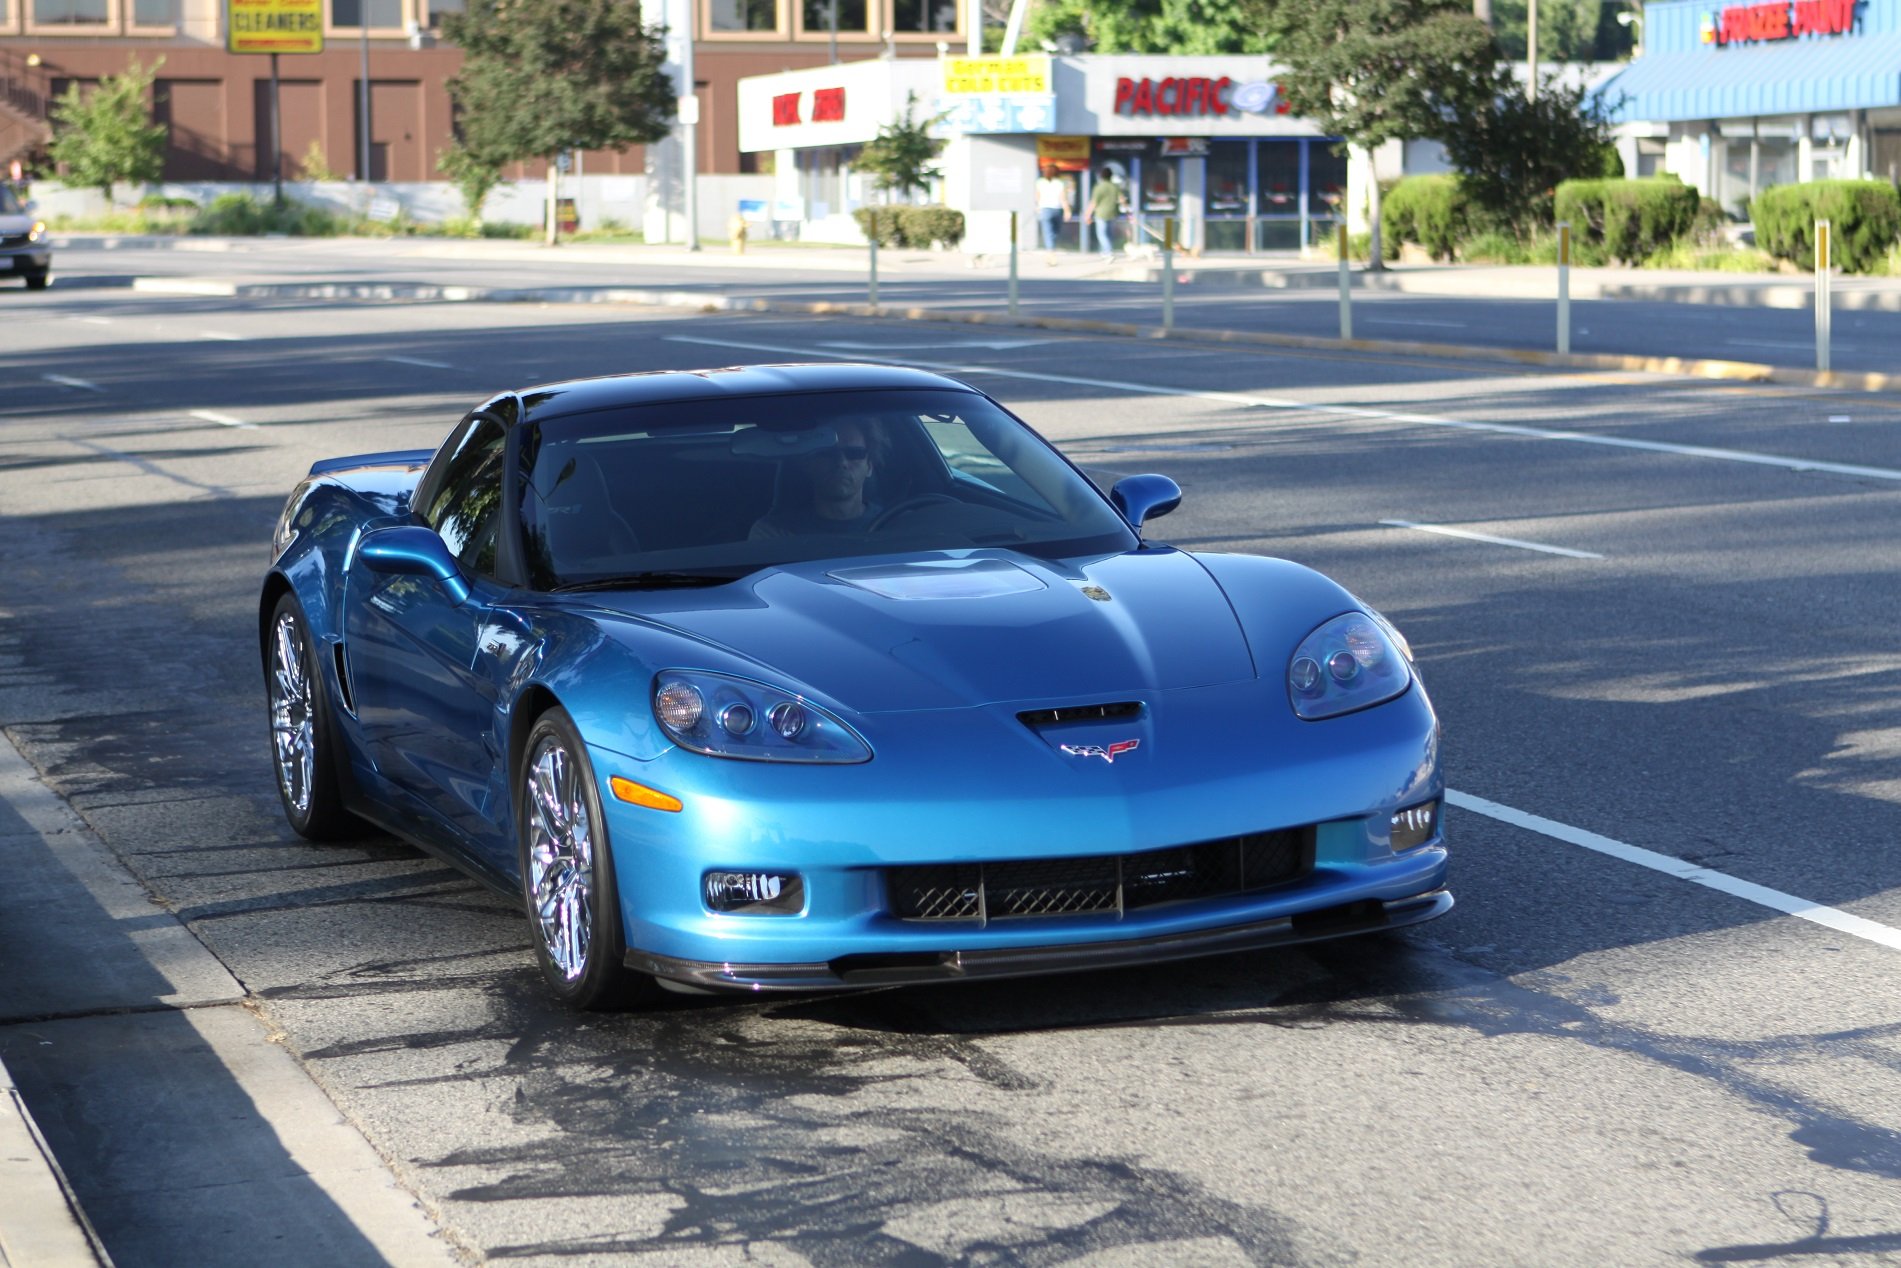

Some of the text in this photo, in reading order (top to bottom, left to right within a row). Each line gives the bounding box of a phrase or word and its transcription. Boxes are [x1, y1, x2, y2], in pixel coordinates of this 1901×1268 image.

[234, 12, 320, 32] CLEANERS
[1719, 0, 1855, 45] FRAZEE PAINT
[1113, 76, 1231, 116] PACIFIC
